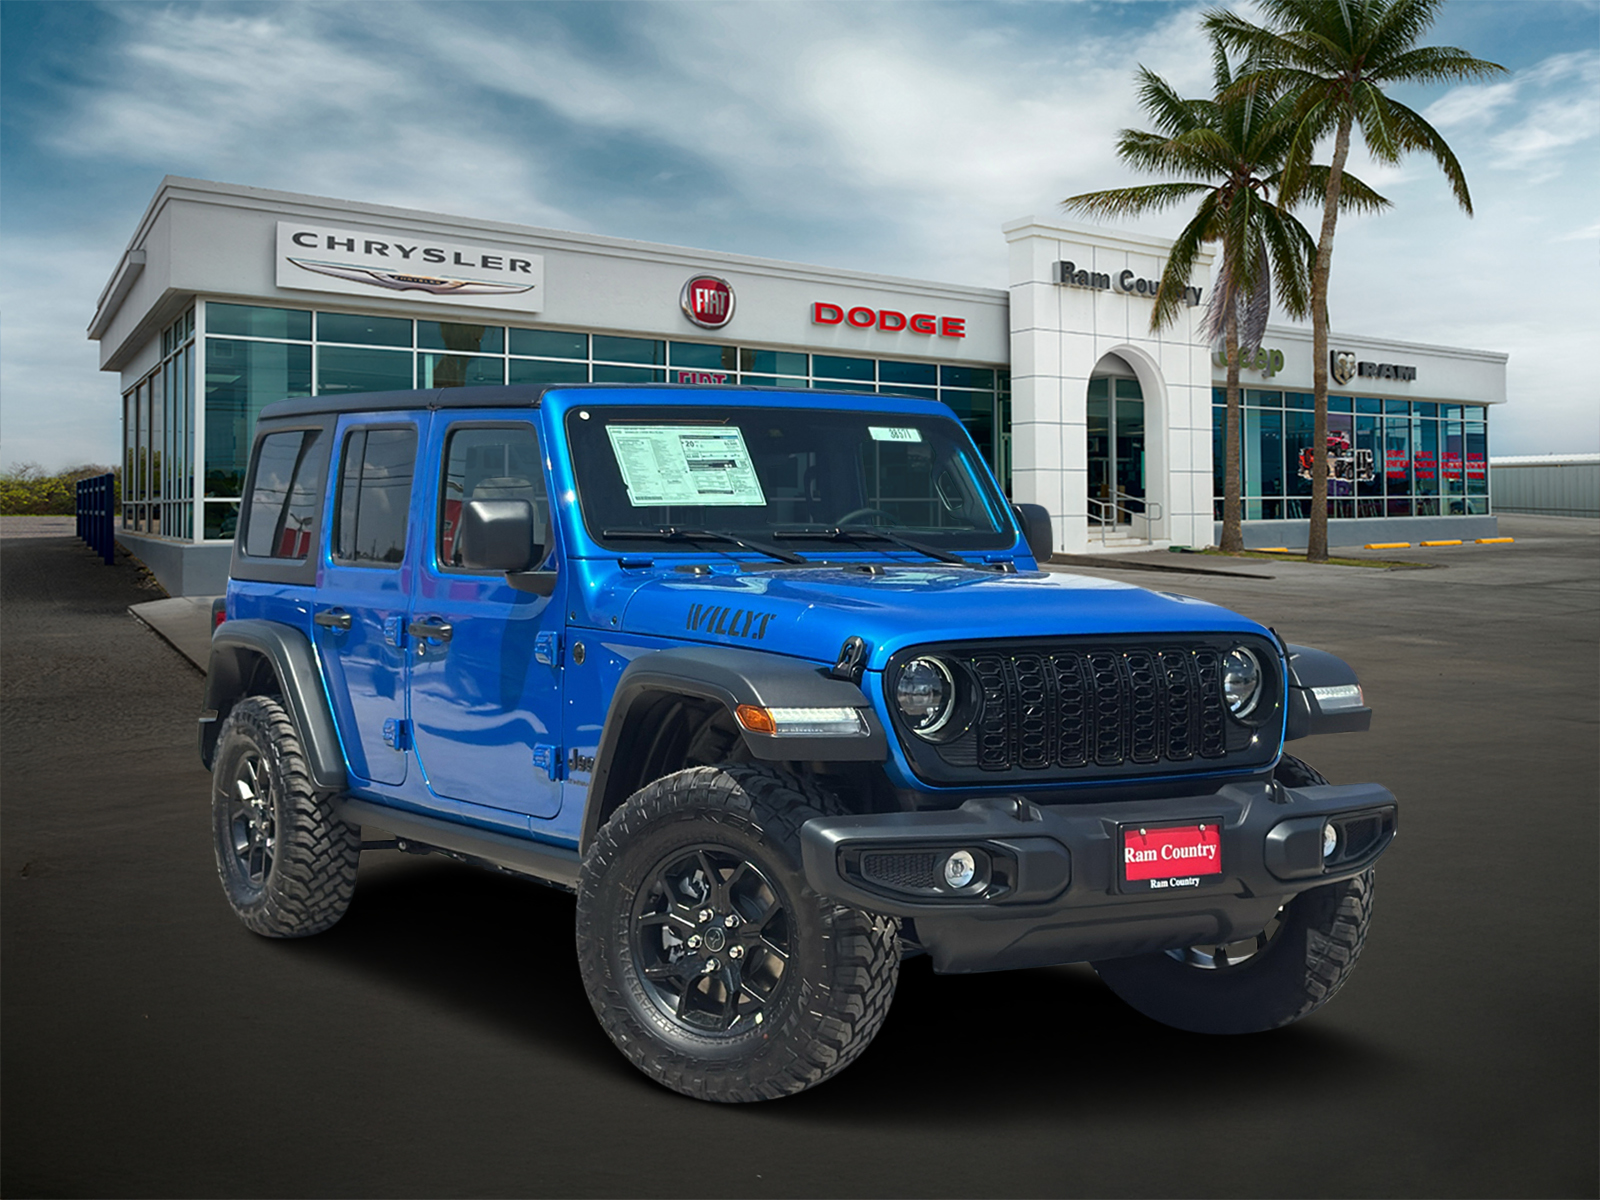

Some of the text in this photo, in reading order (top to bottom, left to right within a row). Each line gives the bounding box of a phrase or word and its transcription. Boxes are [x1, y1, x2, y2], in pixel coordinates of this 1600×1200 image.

[291, 231, 532, 274] CHRYSLER
[1058, 260, 1203, 306] Ram Coury
[695, 287, 728, 316] FIAT
[812, 301, 966, 338] DODGE
[1357, 361, 1417, 381] RAM
[686, 603, 777, 640] WILLYS
[1124, 842, 1217, 864] Ram Country
[1150, 877, 1200, 889] Ram Country
